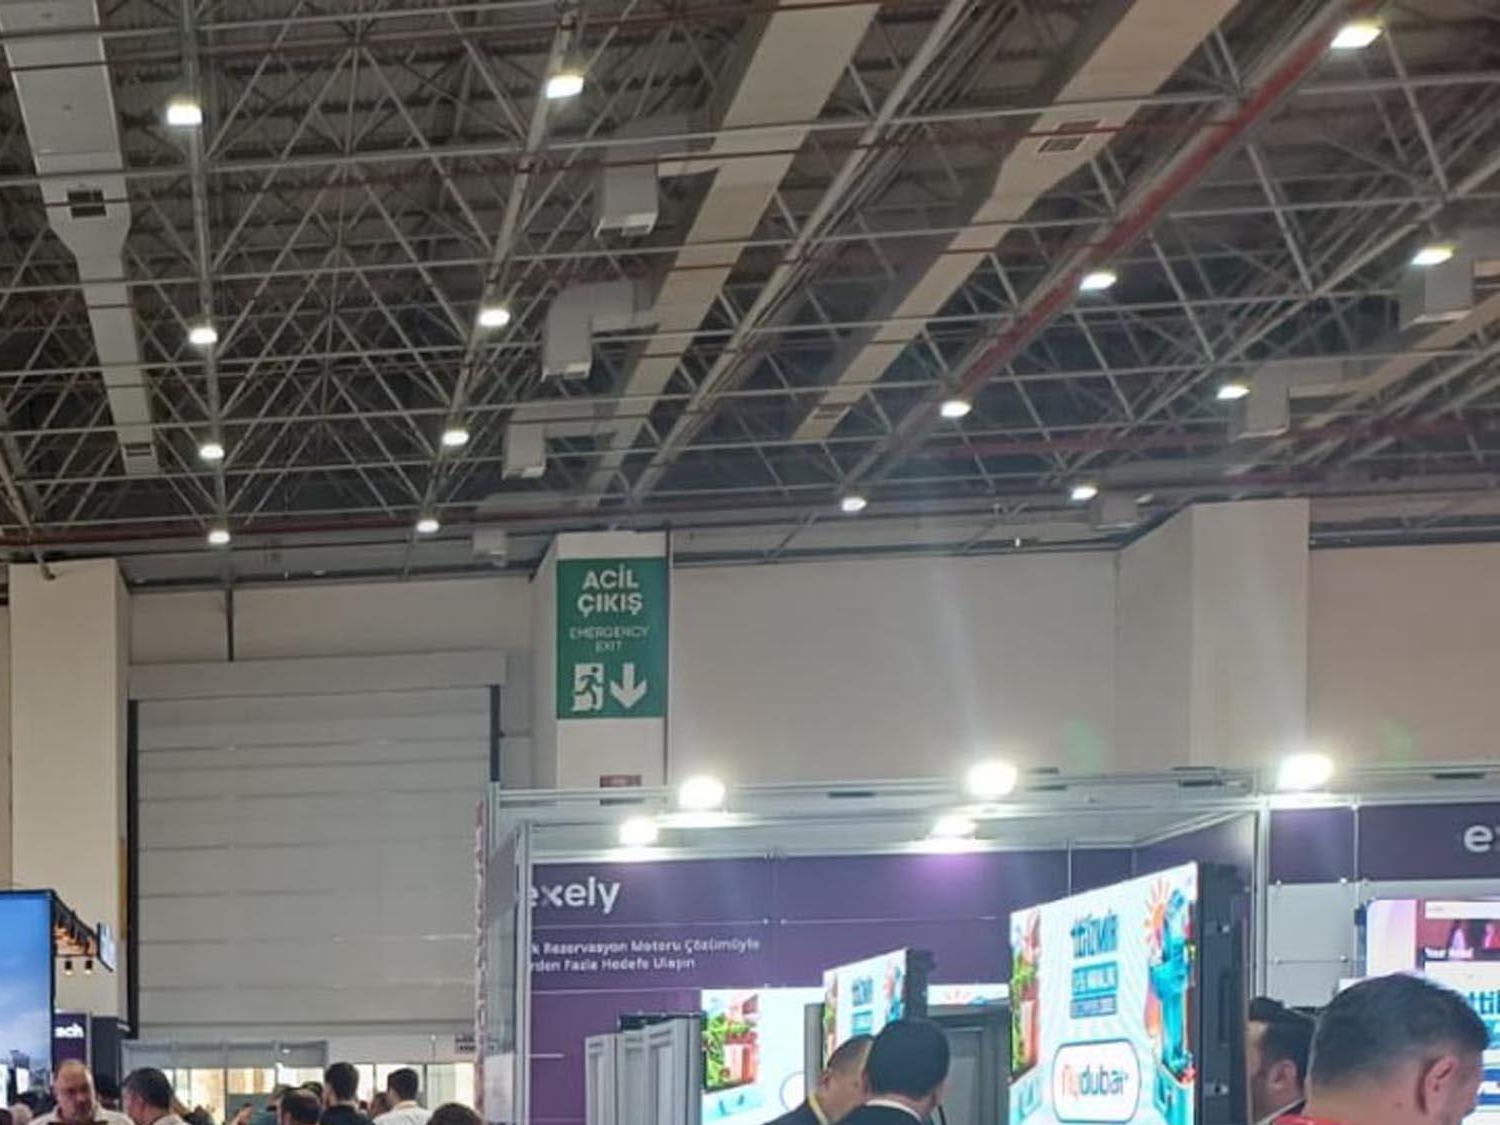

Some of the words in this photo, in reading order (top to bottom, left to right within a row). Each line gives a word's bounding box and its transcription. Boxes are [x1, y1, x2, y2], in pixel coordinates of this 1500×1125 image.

[582, 564, 640, 590] ACİL
[577, 593, 644, 618] ÇIKIŞ
[569, 625, 649, 640] EMERGENCY
[595, 641, 622, 652] EXIT
[543, 941, 628, 956] Rezervasyon
[631, 940, 681, 953] Motoru
[564, 958, 598, 972] Fazla
[601, 957, 649, 971] Hedefe
